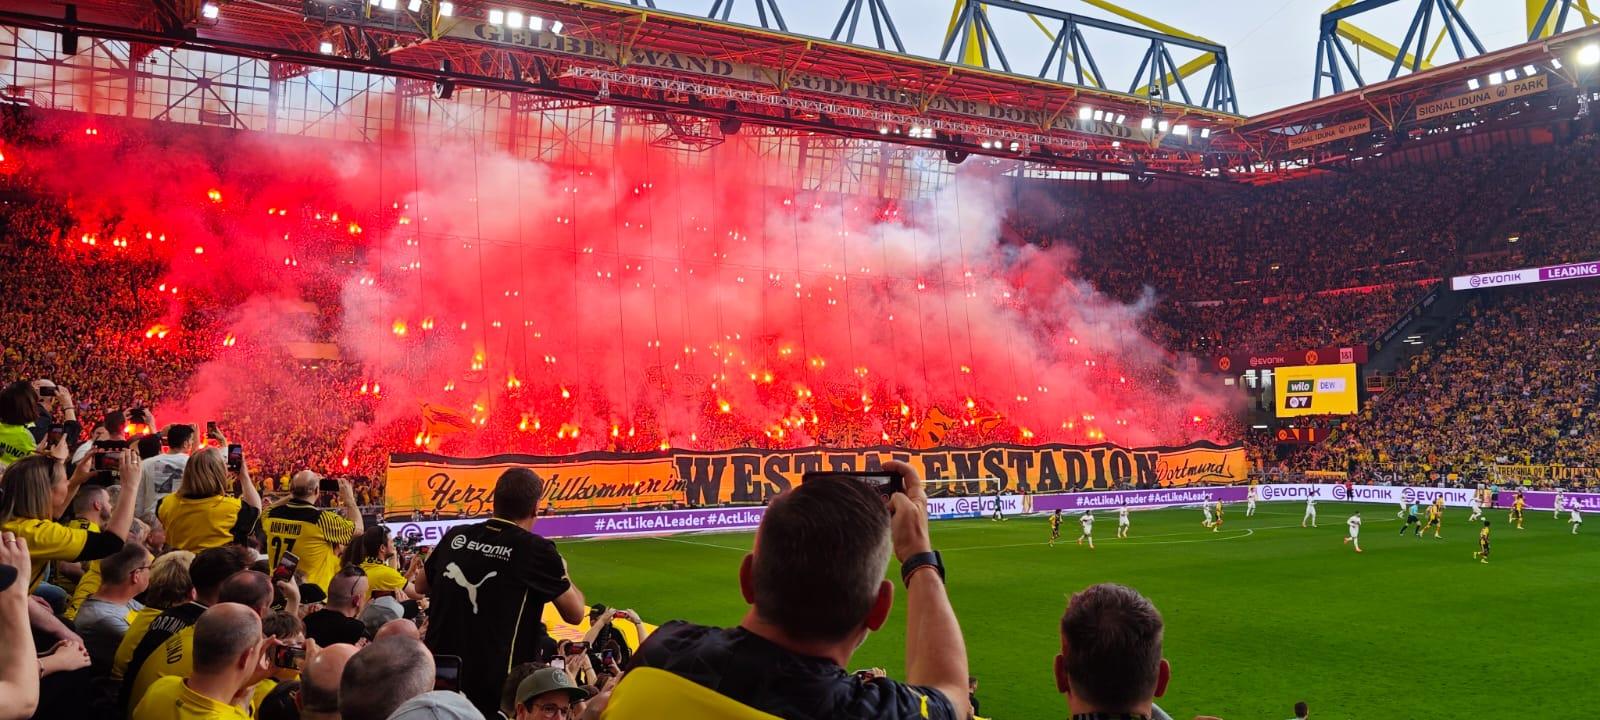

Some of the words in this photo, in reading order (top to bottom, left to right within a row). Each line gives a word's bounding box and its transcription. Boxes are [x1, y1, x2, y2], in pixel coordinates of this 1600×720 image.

[474, 23, 606, 58] GELBE
[630, 50, 734, 76] WAND
[1418, 101, 1456, 116] SIGNAL
[1458, 92, 1491, 107] IDUNA
[1513, 78, 1544, 94] PARK
[1315, 130, 1336, 140] IDUNA
[1348, 123, 1367, 133] PARK
[1481, 273, 1521, 285] EVONIK
[1548, 264, 1598, 279] LEADING
[1290, 381, 1310, 391] wilo
[1157, 453, 1227, 481] Dortmund
[663, 473, 688, 492] im
[674, 449, 1159, 505] WESENSTADION
[1416, 490, 1467, 503] EVONIK
[594, 514, 706, 531] #ActLikeALeader
[707, 511, 761, 526] #ActLike
[466, 540, 513, 558] EVONIK
